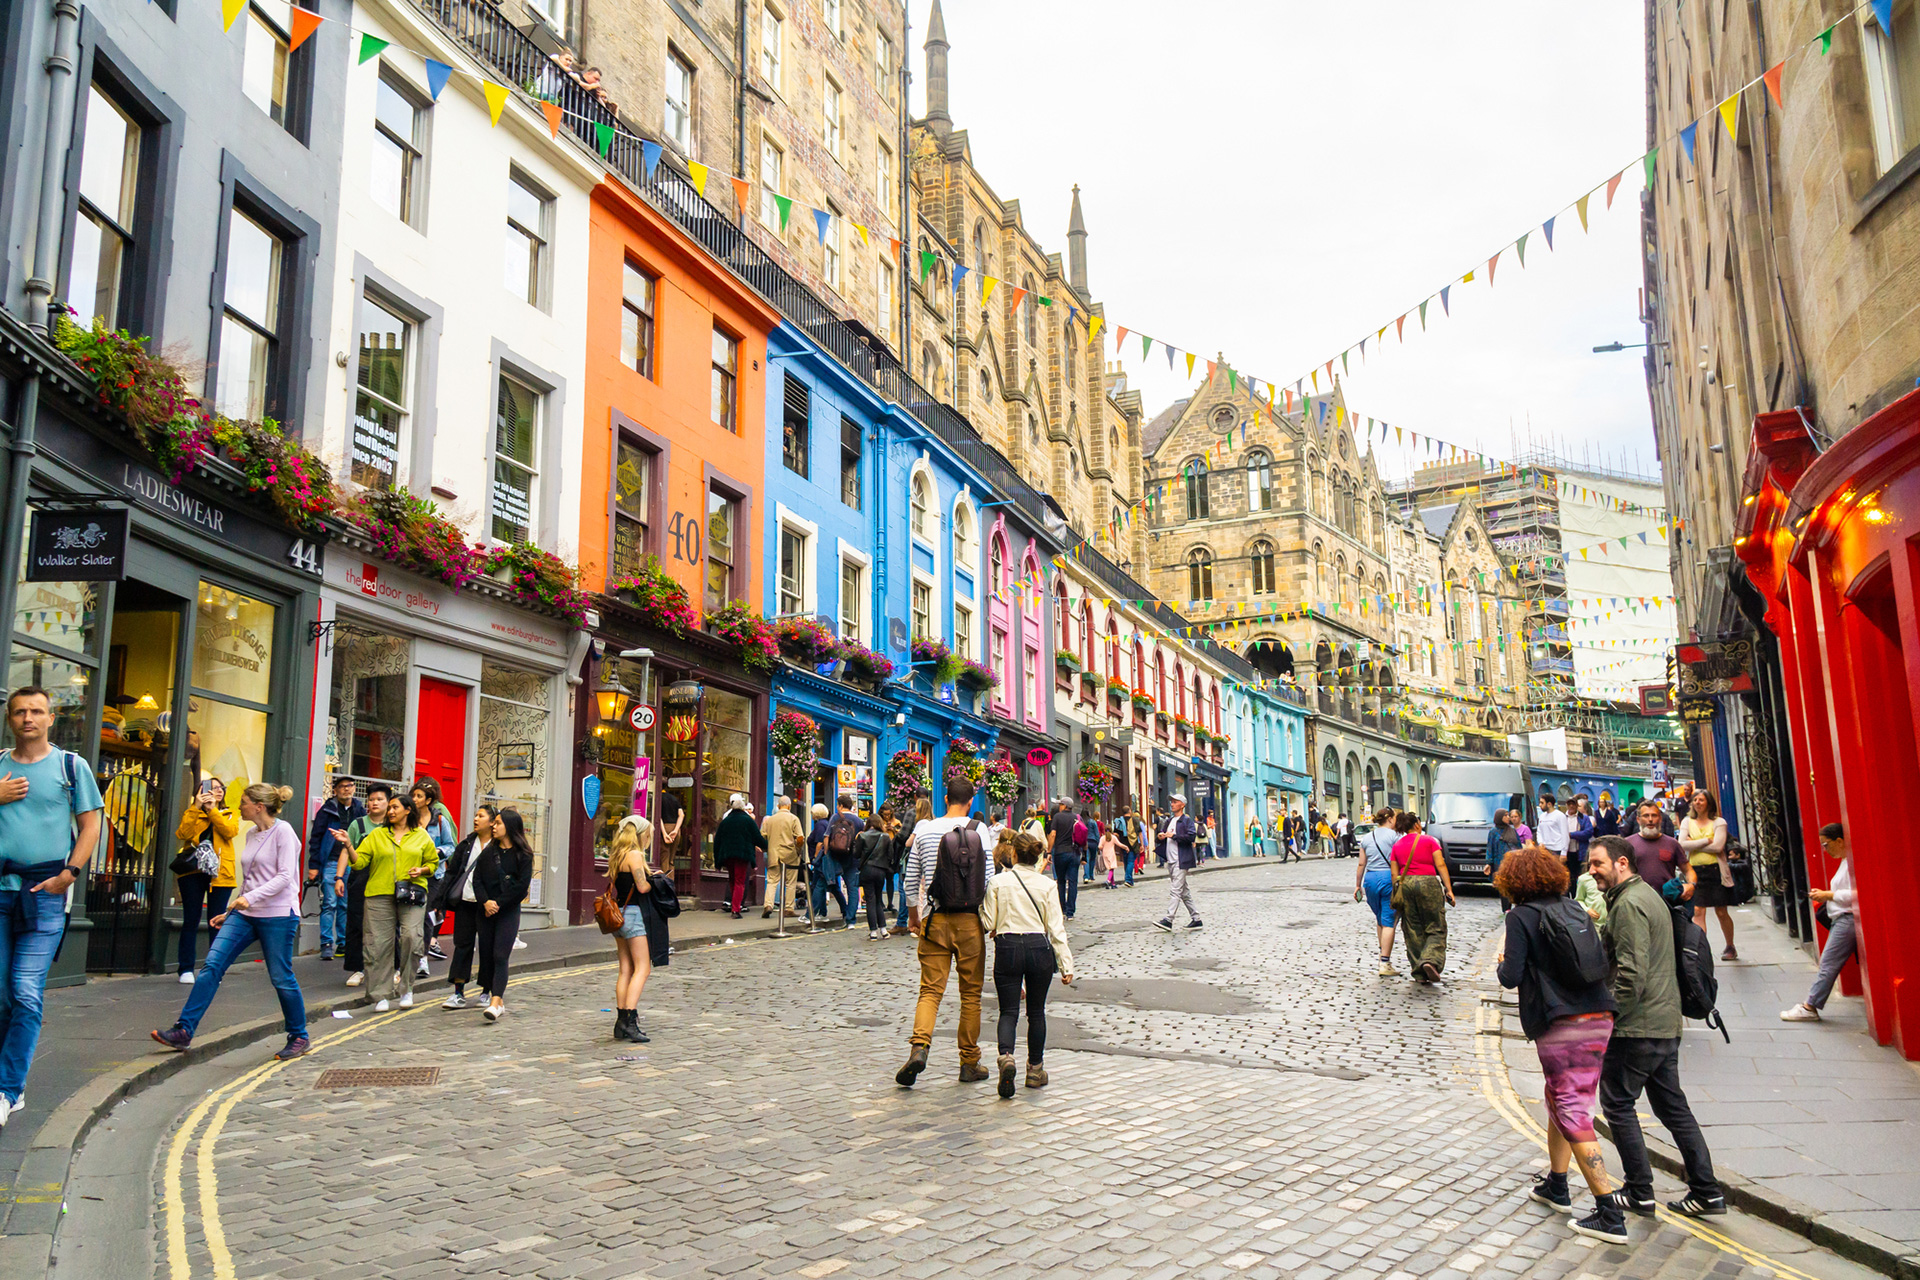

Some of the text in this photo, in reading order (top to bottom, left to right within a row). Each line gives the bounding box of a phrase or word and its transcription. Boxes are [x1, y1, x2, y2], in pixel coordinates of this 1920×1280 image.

[354, 431, 399, 463] and Design
[375, 423, 397, 445] Local
[351, 444, 393, 475] ince 2003
[123, 463, 223, 533] LADIESWEAR
[614, 532, 637, 548] ORLD
[668, 511, 700, 566] 40
[38, 554, 116, 566] Walker Slater
[346, 568, 440, 615] the red door gallery
[633, 712, 653, 724] 20
[609, 749, 632, 766] CONTE
